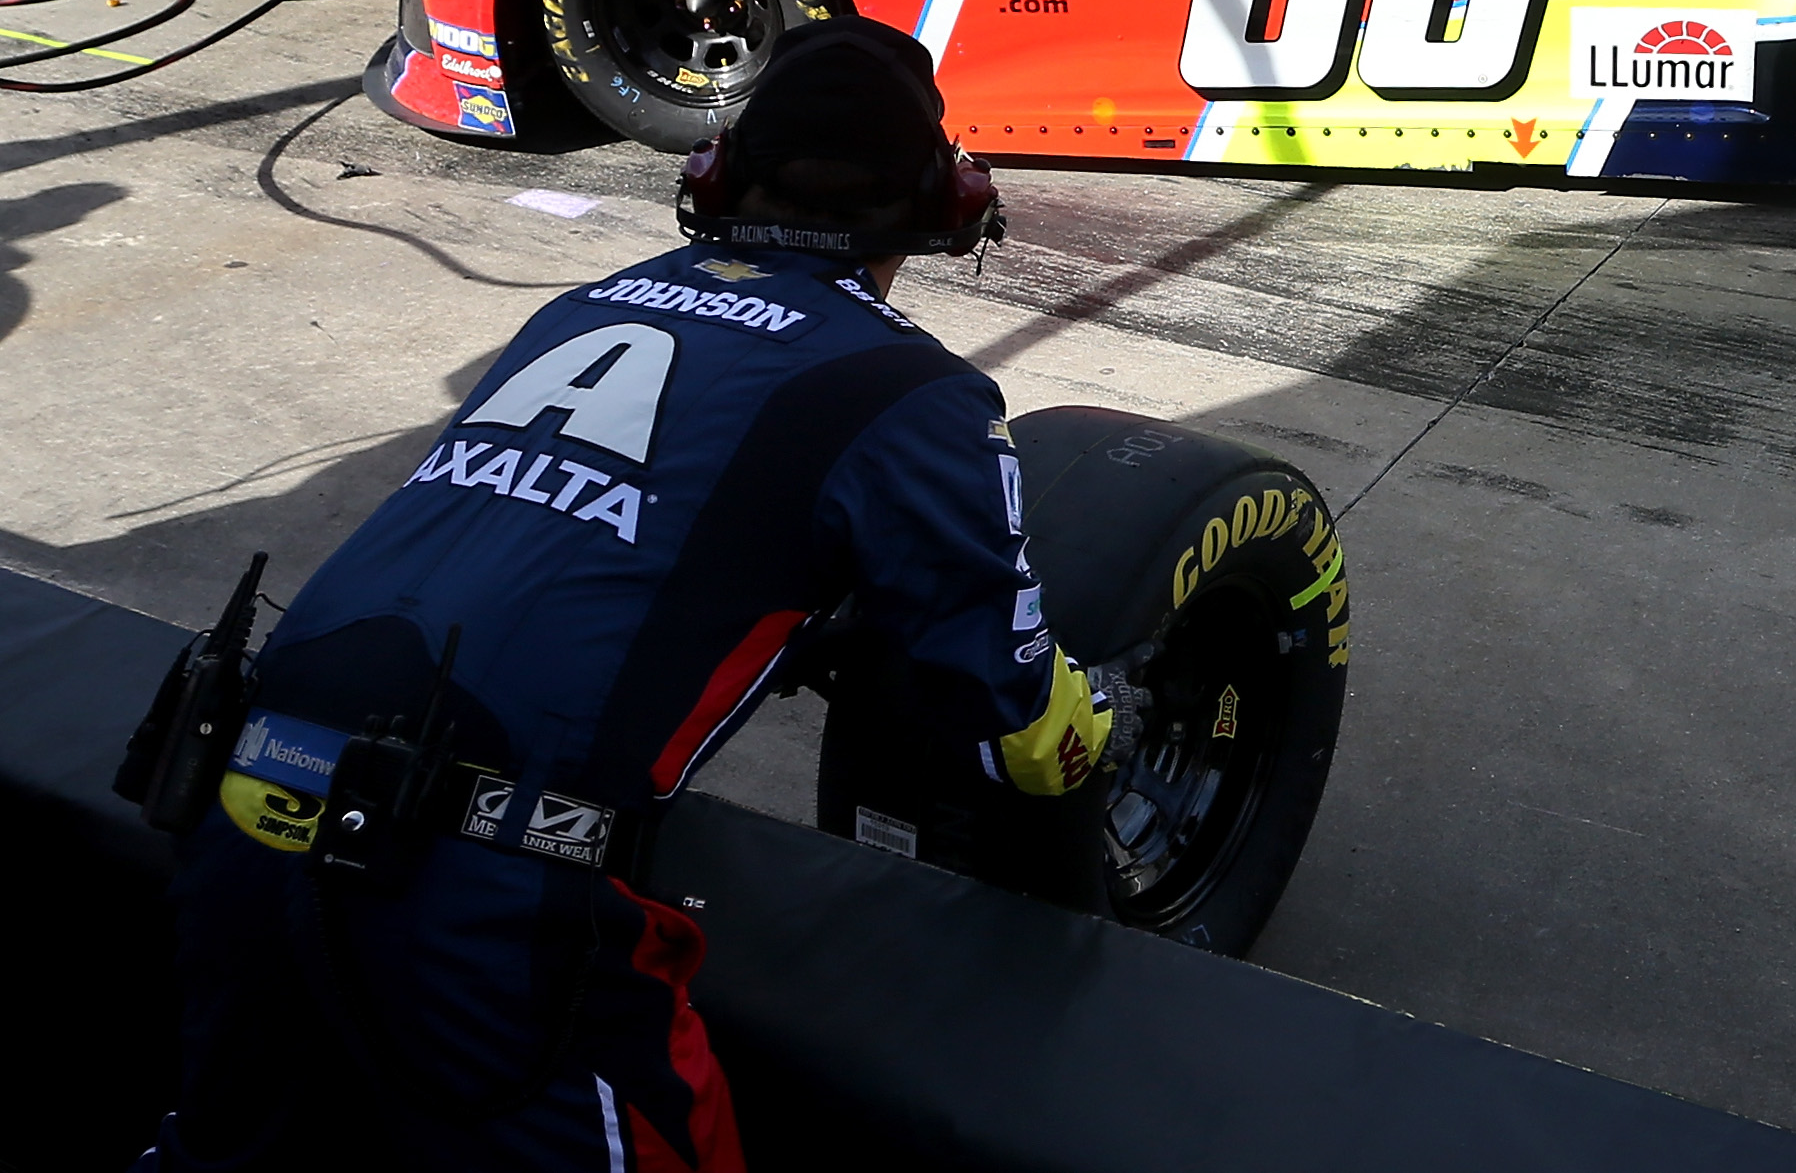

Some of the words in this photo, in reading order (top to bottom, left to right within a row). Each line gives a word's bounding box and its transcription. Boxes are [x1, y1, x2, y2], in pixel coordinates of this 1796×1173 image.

[428, 17, 497, 57] MOOG
[1590, 45, 1735, 89] LLumar
[462, 100, 505, 119] SUNOCO
[730, 225, 770, 244] RACING
[782, 229, 851, 251] ELECTRONICS
[928, 237, 953, 247] CALE
[588, 277, 807, 333] JOHNSON
[402, 440, 642, 546] AXALTA
[1172, 487, 1350, 669] GOODYEAR
[1220, 693, 1234, 732] AERO
[264, 737, 337, 777] Nationw
[255, 813, 312, 846] SIMPSON
[467, 815, 557, 855] MEANIX
